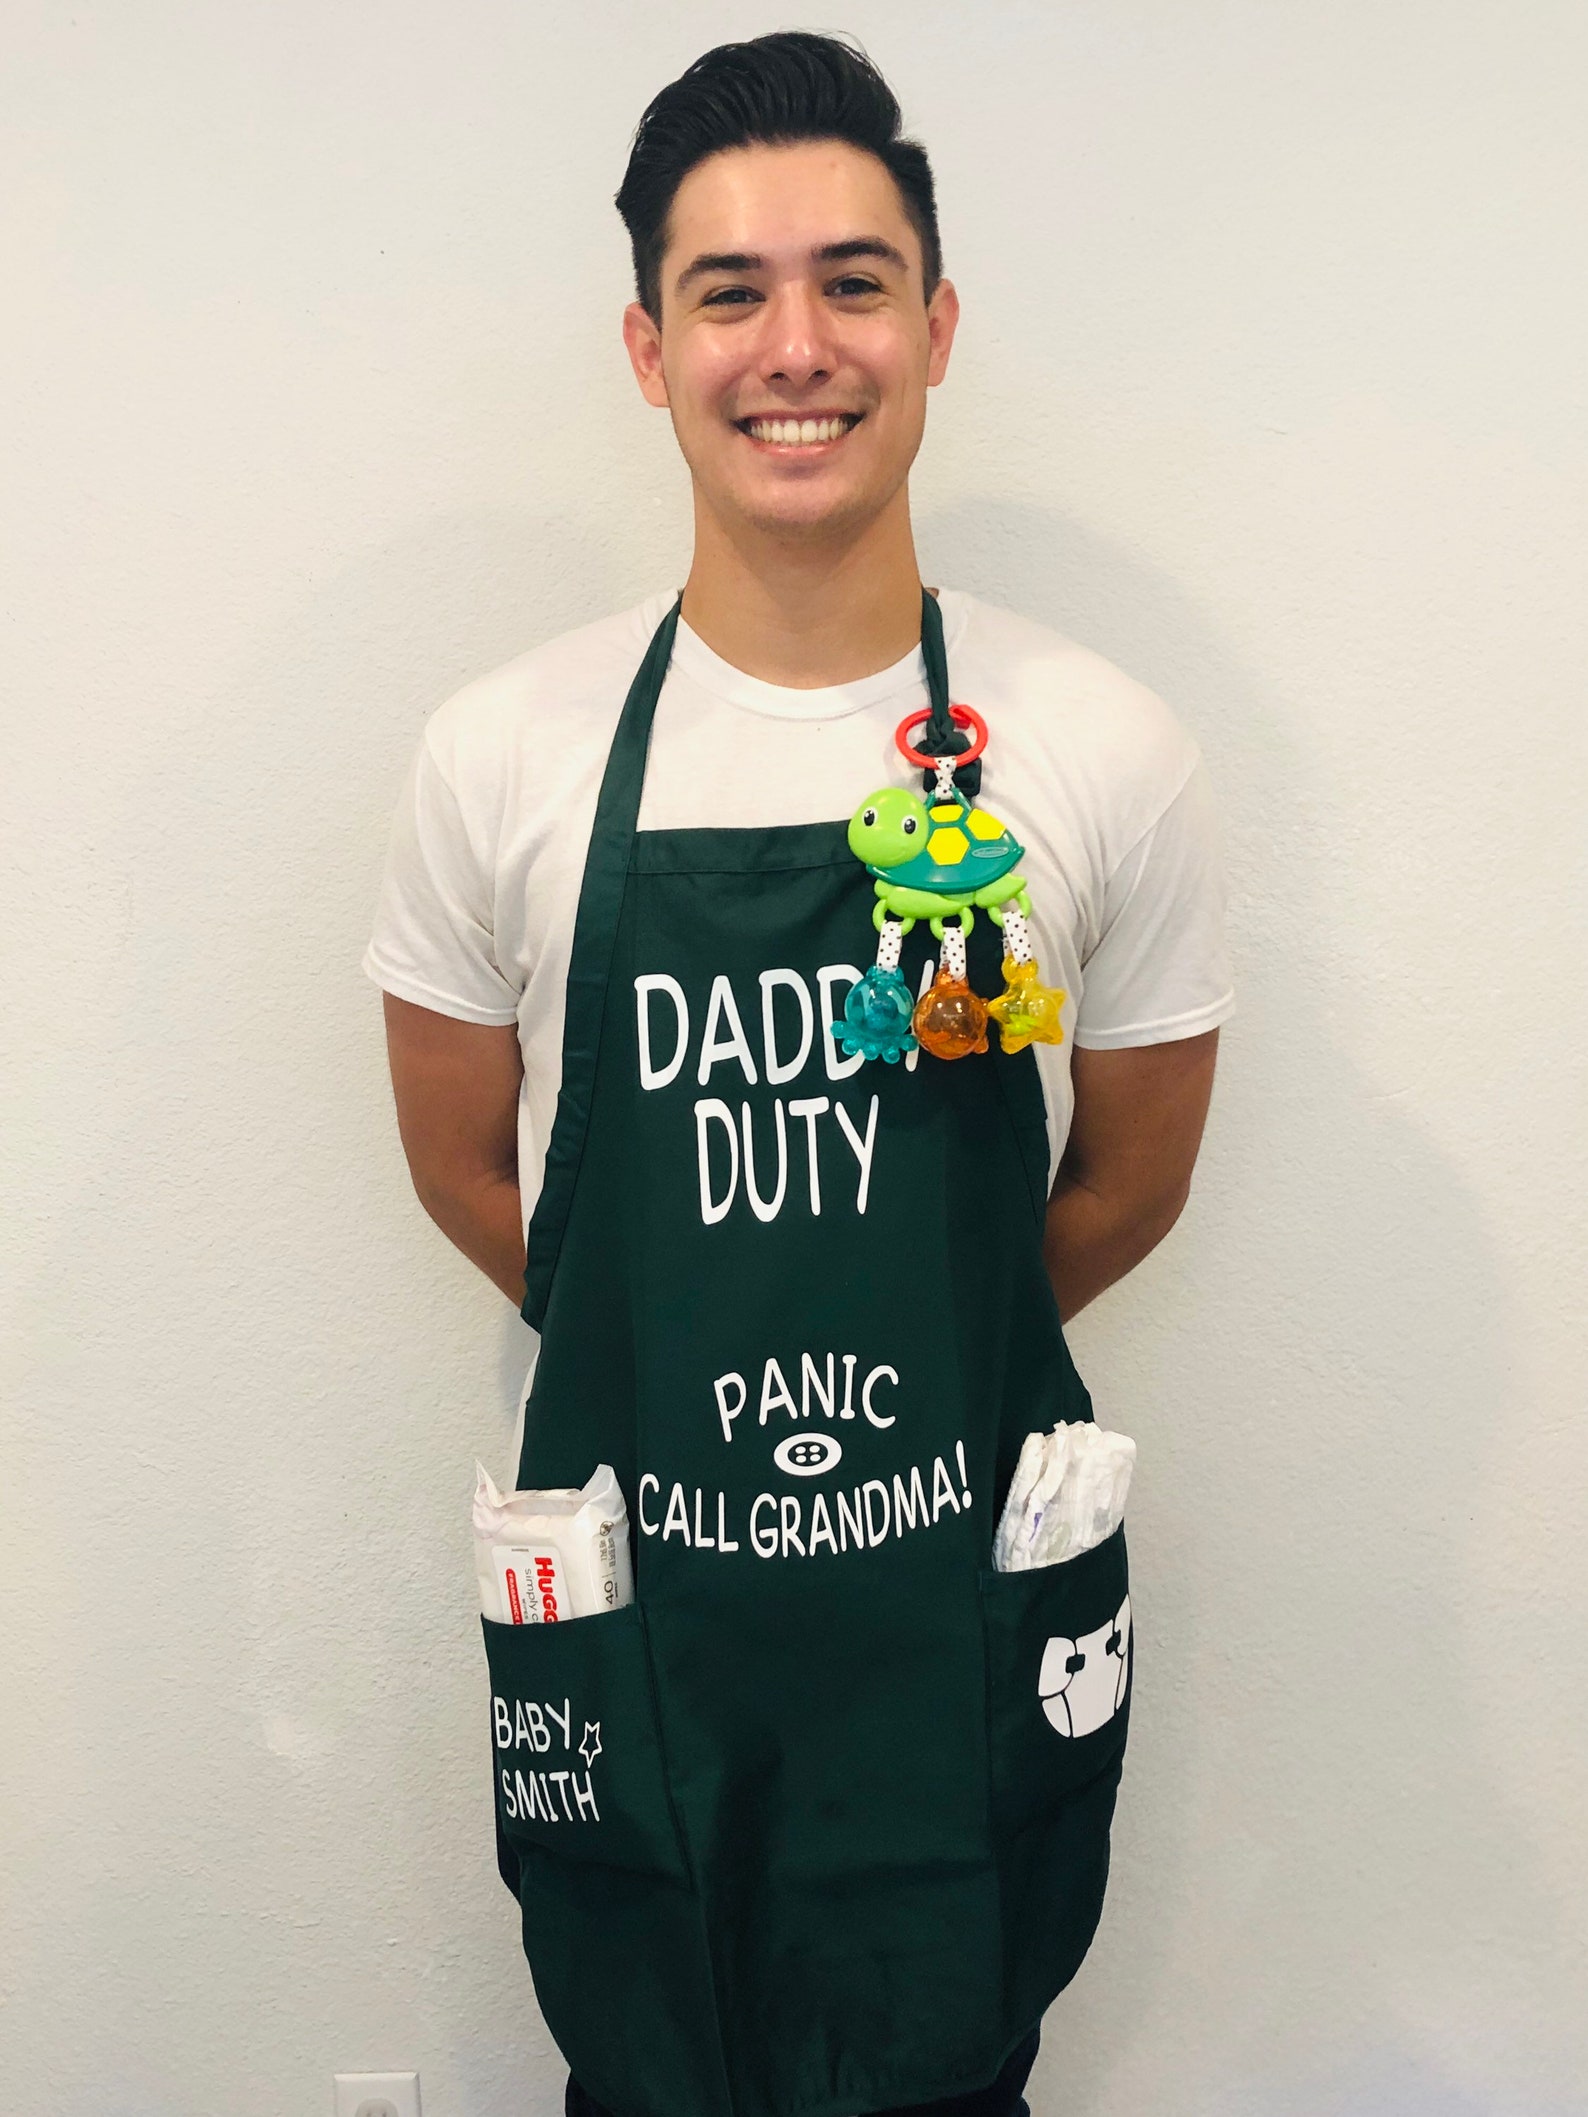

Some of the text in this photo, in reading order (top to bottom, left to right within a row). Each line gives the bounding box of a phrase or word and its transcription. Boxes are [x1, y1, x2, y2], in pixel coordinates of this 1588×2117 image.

[693, 1094, 879, 1225] DUTY
[713, 1352, 899, 1443] PANIC
[638, 1439, 973, 1559] CALL GRANDMA!
[507, 1572, 521, 1622] FRAGRANCE
[525, 1568, 539, 1612] simply
[603, 1580, 614, 1605] 40
[493, 1696, 570, 1753] BABY
[502, 1768, 600, 1822] SMITH
